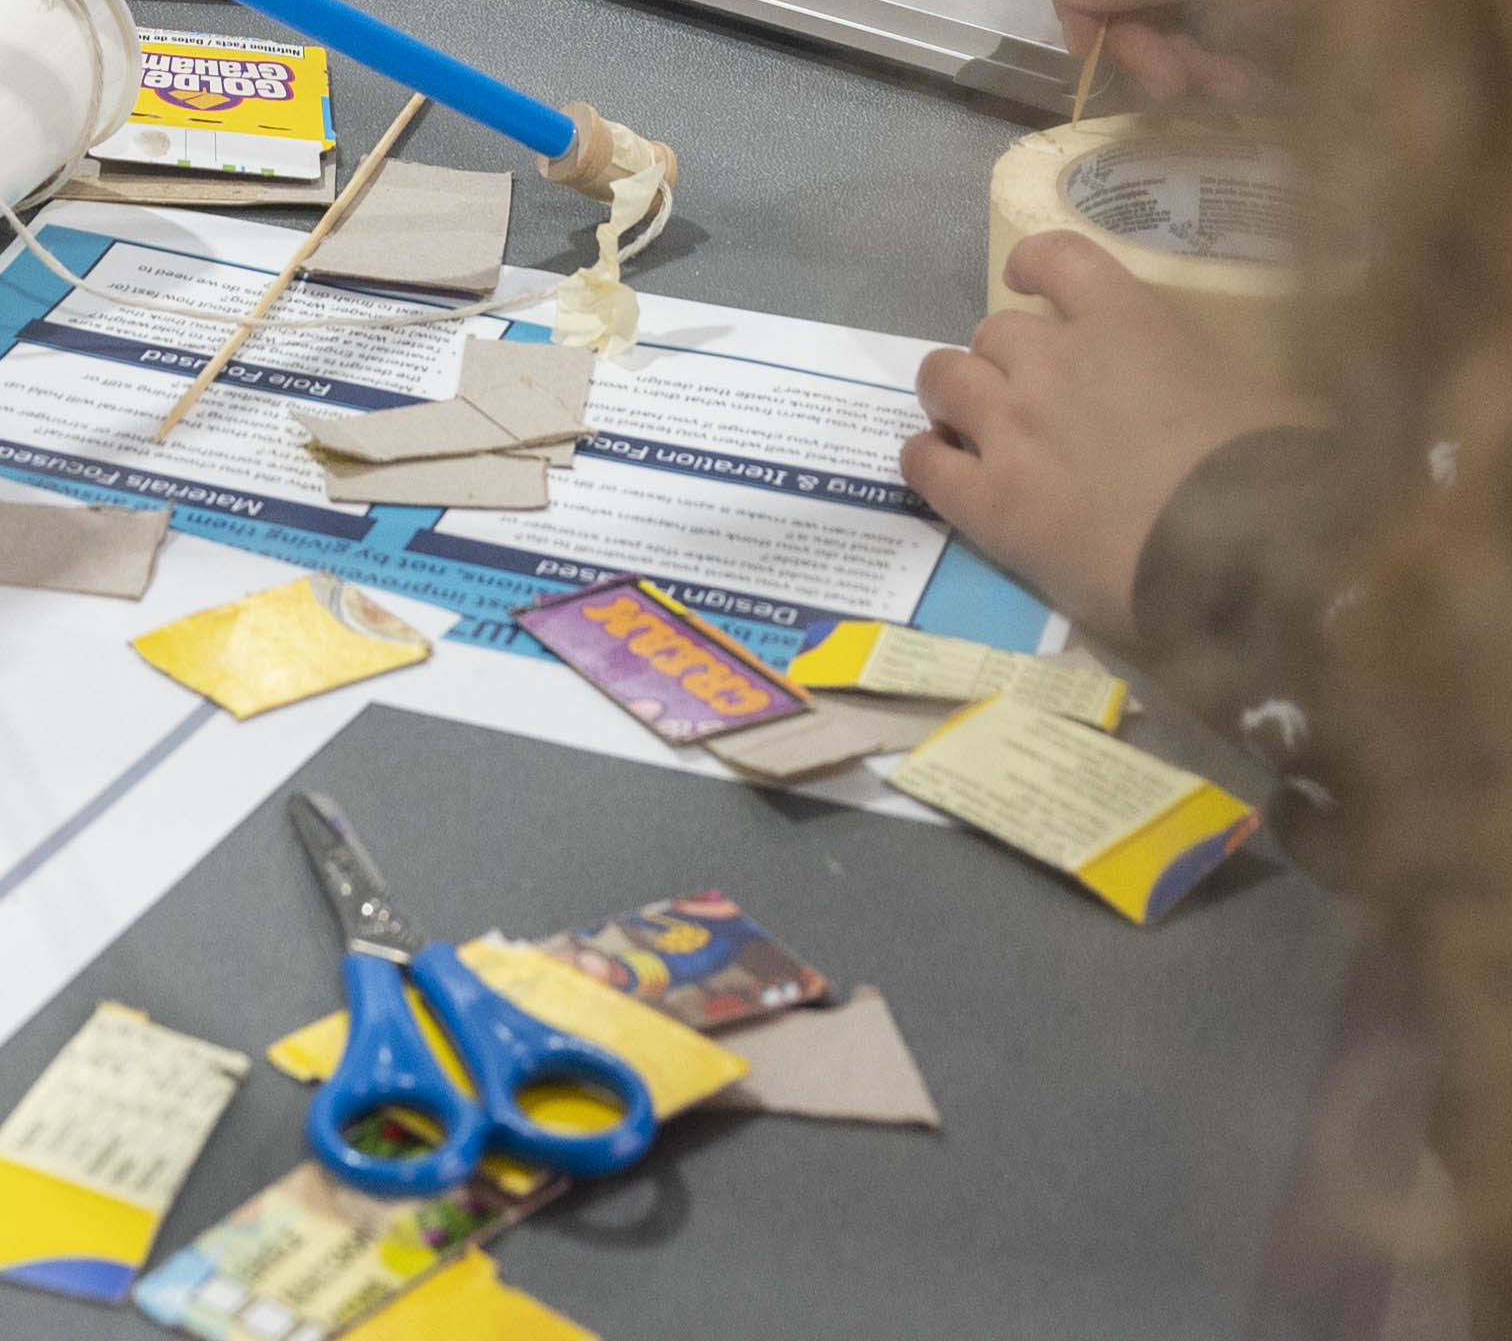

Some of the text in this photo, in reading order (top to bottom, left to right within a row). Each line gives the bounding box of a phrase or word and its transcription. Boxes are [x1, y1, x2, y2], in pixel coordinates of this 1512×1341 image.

[152, 34, 167, 44] de
[170, 35, 203, 47] Datos
[215, 39, 245, 51] Facts
[249, 42, 300, 56] Nutrition
[137, 346, 335, 398] Role Foused
[650, 447, 790, 487] Iteration
[118, 470, 267, 518] Materials
[790, 472, 822, 493] &
[184, 509, 256, 538] them
[263, 524, 351, 558] giving
[356, 544, 390, 566] by
[533, 556, 802, 626] Design Fused
